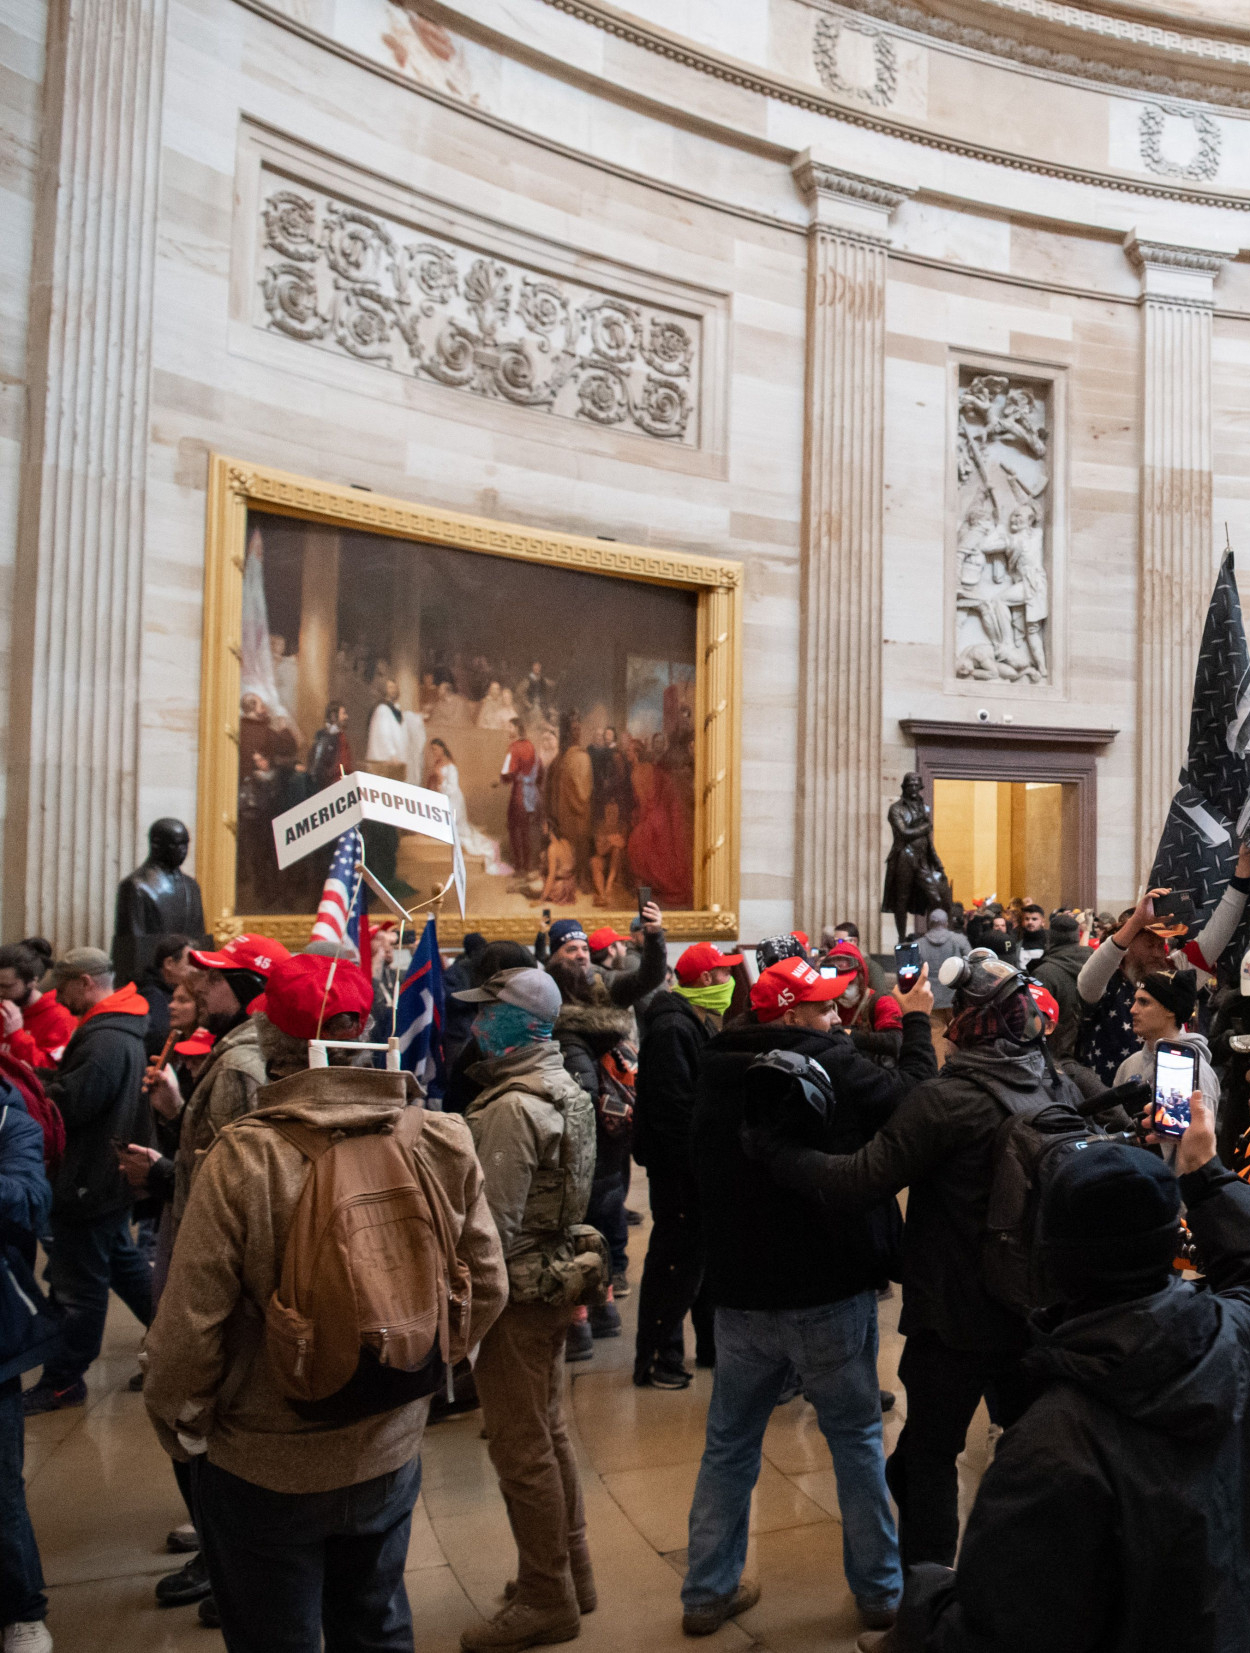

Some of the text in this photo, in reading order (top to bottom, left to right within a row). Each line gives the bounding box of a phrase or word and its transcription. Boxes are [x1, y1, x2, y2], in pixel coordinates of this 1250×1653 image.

[1004, 940, 1012, 952] P
[254, 955, 272, 969] 45
[778, 987, 795, 1007] 45
